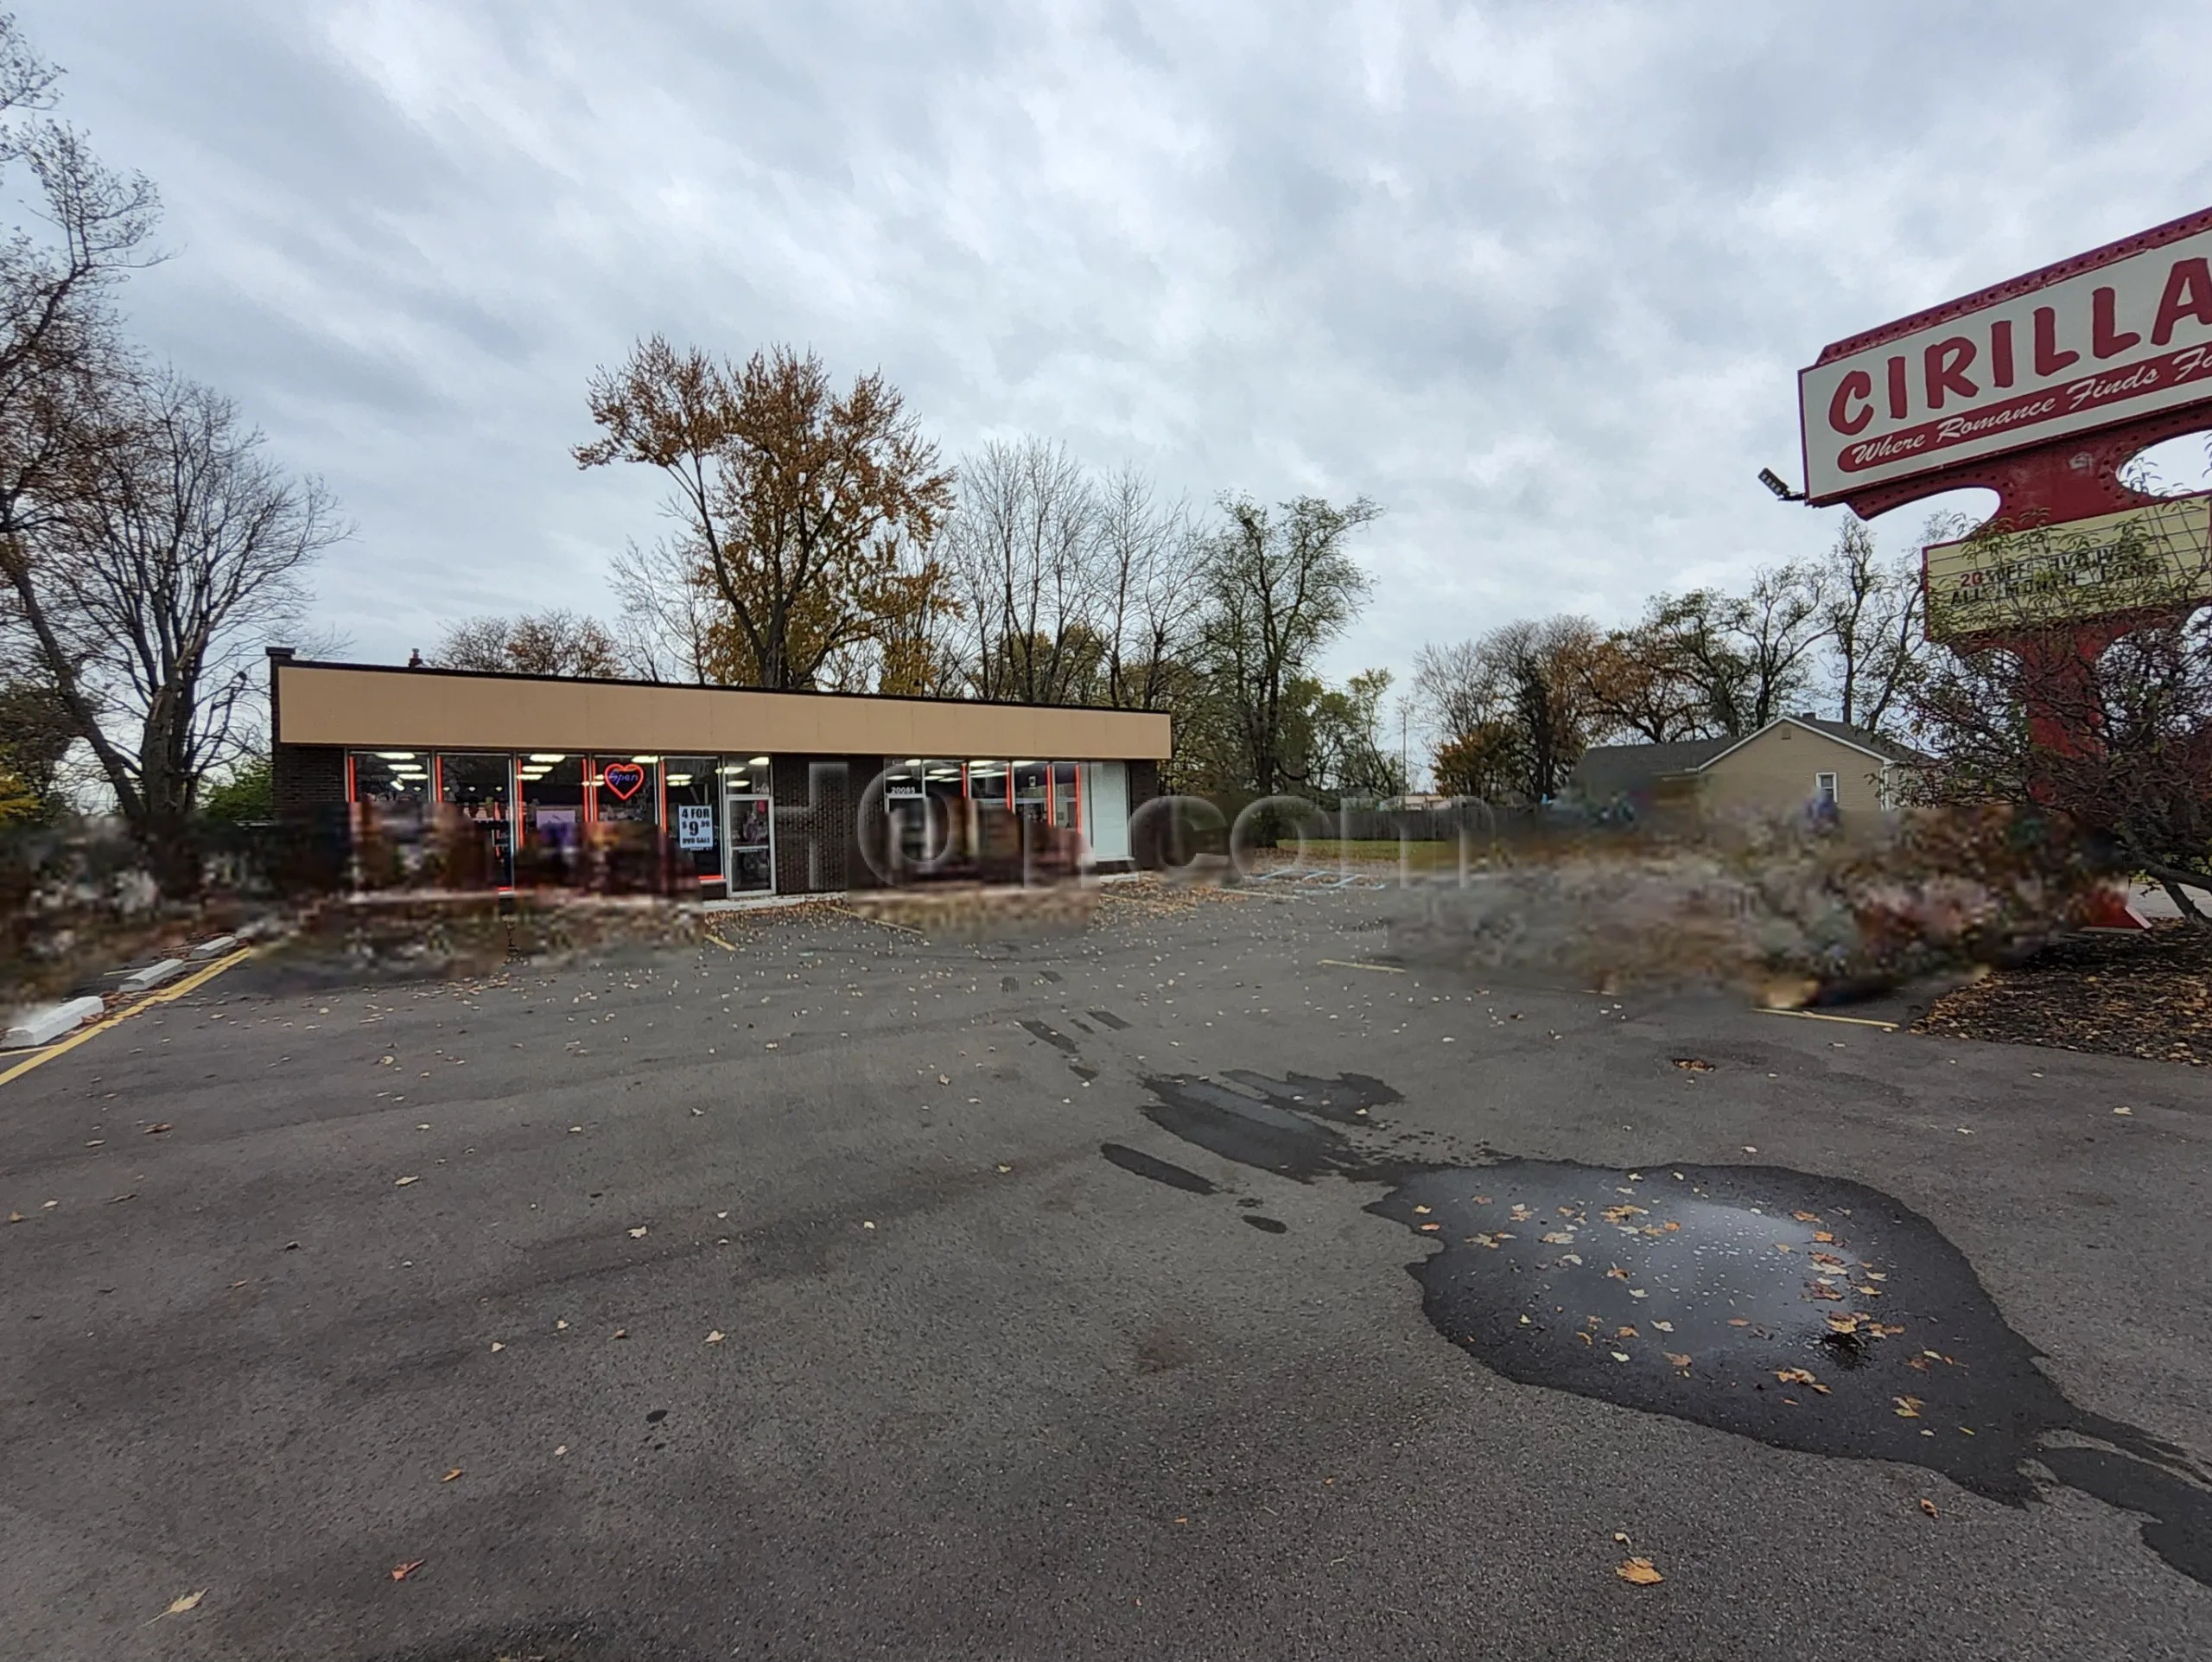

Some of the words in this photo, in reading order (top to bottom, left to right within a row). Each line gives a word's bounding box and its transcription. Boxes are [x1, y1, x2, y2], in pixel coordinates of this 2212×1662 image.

[1828, 257, 2212, 436] CIRILLA
[1851, 435, 1926, 464] Where
[1935, 397, 2057, 443] Romance
[2066, 365, 2160, 411] Finds
[682, 808, 689, 818] 4
[691, 808, 710, 818] FOR
